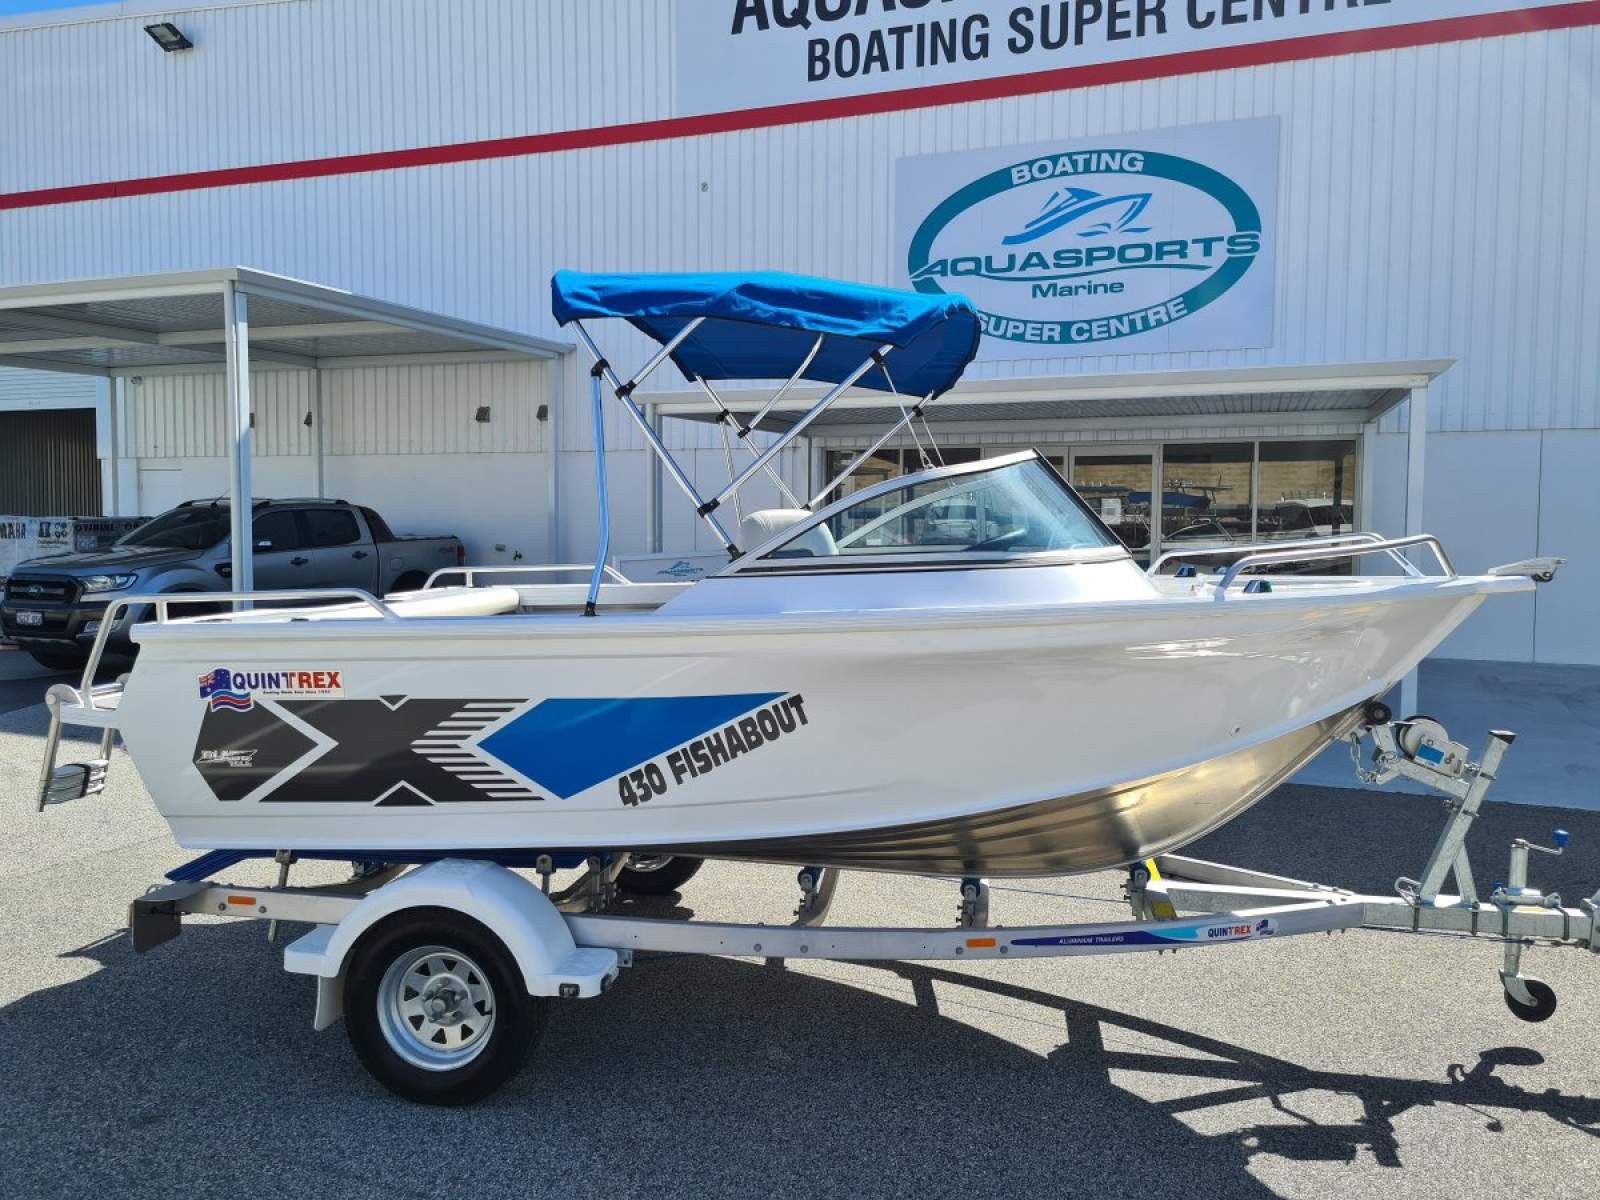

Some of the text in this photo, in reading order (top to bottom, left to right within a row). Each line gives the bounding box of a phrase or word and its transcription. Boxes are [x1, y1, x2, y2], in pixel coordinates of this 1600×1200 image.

[808, 13, 990, 82] BOATING
[1007, 0, 1167, 54] SUPER
[1011, 152, 1145, 185] BOATING
[911, 233, 1261, 279] AQUASPORTS
[1031, 280, 1125, 299] Marine
[1070, 297, 1188, 341] CENTRE
[232, 672, 341, 690] QUINTREX
[618, 693, 809, 807] 430 FISHABOUT
[1208, 925, 1252, 938] QUINTREX
